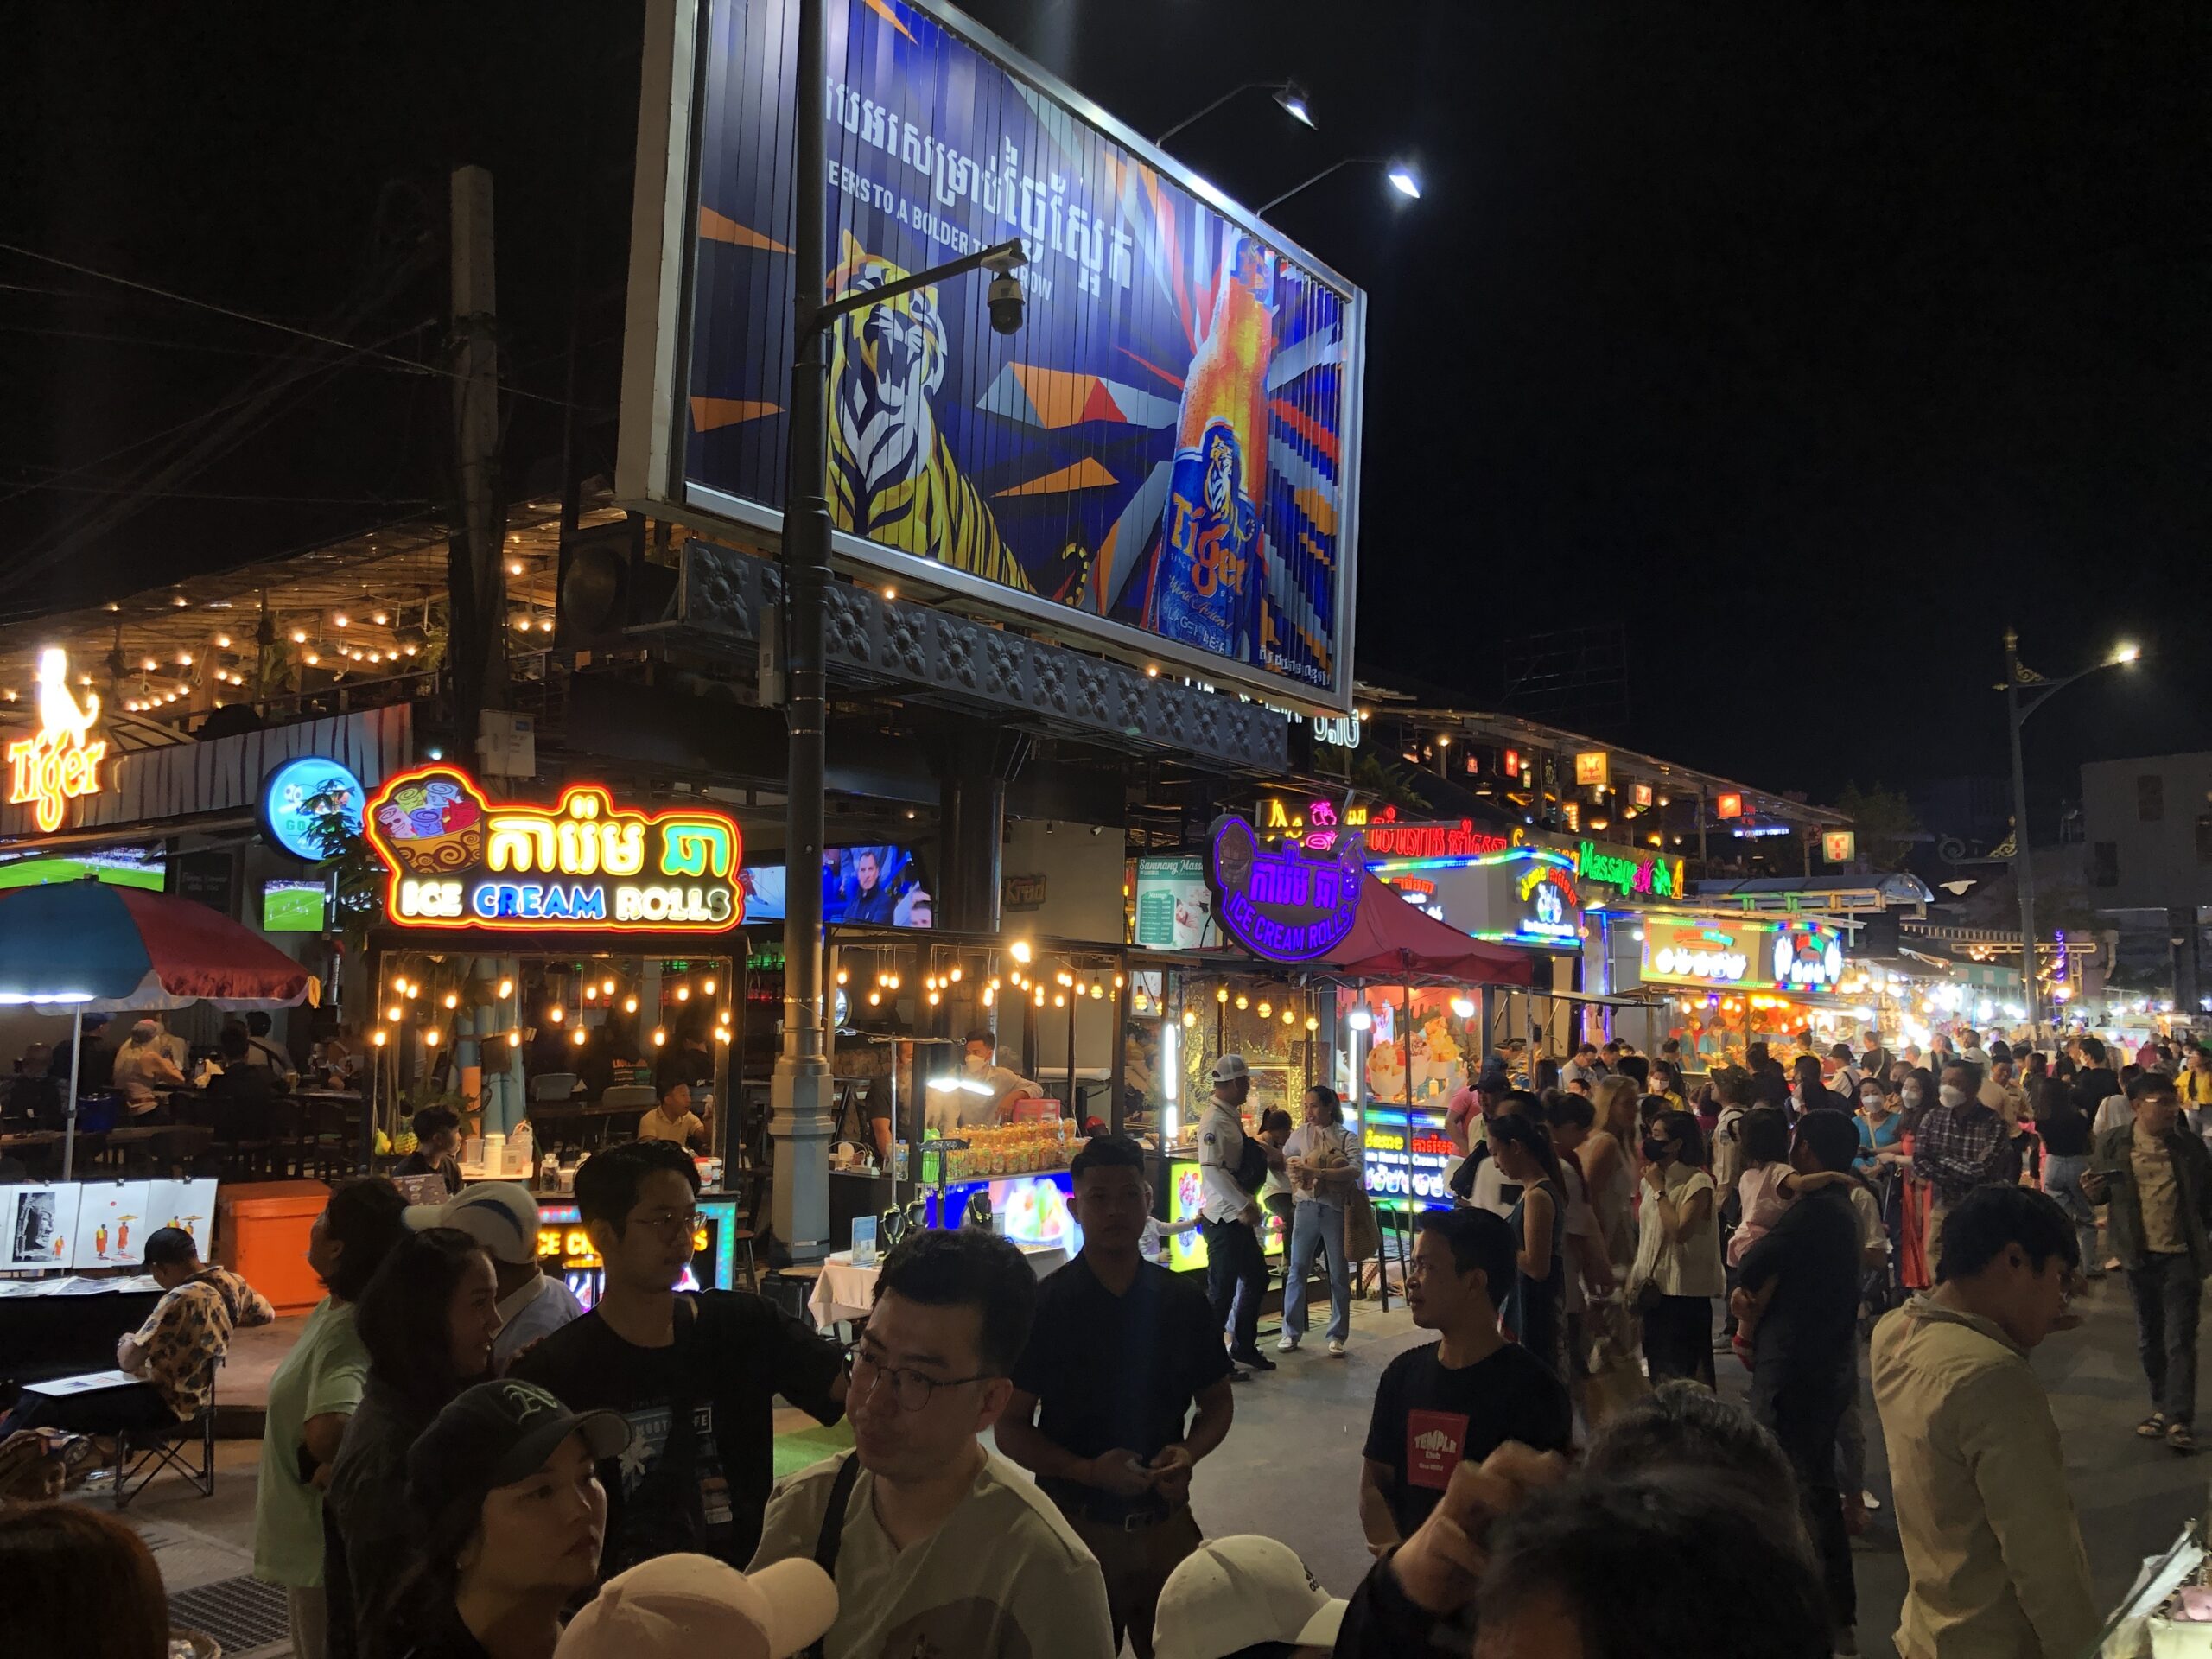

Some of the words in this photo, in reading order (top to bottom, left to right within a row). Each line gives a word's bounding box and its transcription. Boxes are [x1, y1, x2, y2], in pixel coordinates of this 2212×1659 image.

[826, 76, 1132, 298] បអរសម្រាប់ថ្ងៃស្អែក
[828, 160, 870, 203] EERS
[873, 184, 893, 214] TO
[897, 199, 908, 224] A
[912, 206, 969, 256] BOLDER
[973, 238, 1052, 302] TROW
[1172, 492, 1246, 598] Tiger
[9, 731, 105, 833] Tiger
[1140, 859, 1178, 875] Samnang
[1180, 860, 1203, 872] Mass
[1580, 841, 1637, 896] Massage
[401, 880, 463, 917] ICE
[473, 883, 606, 919] CREAM
[616, 887, 731, 922] ROLLS
[1229, 891, 1255, 926] ICE
[1255, 912, 1305, 951] CREAM
[1308, 904, 1351, 950] ROLLS
[537, 1232, 561, 1255] CE
[1414, 1429, 1457, 1454] TEMPLE
